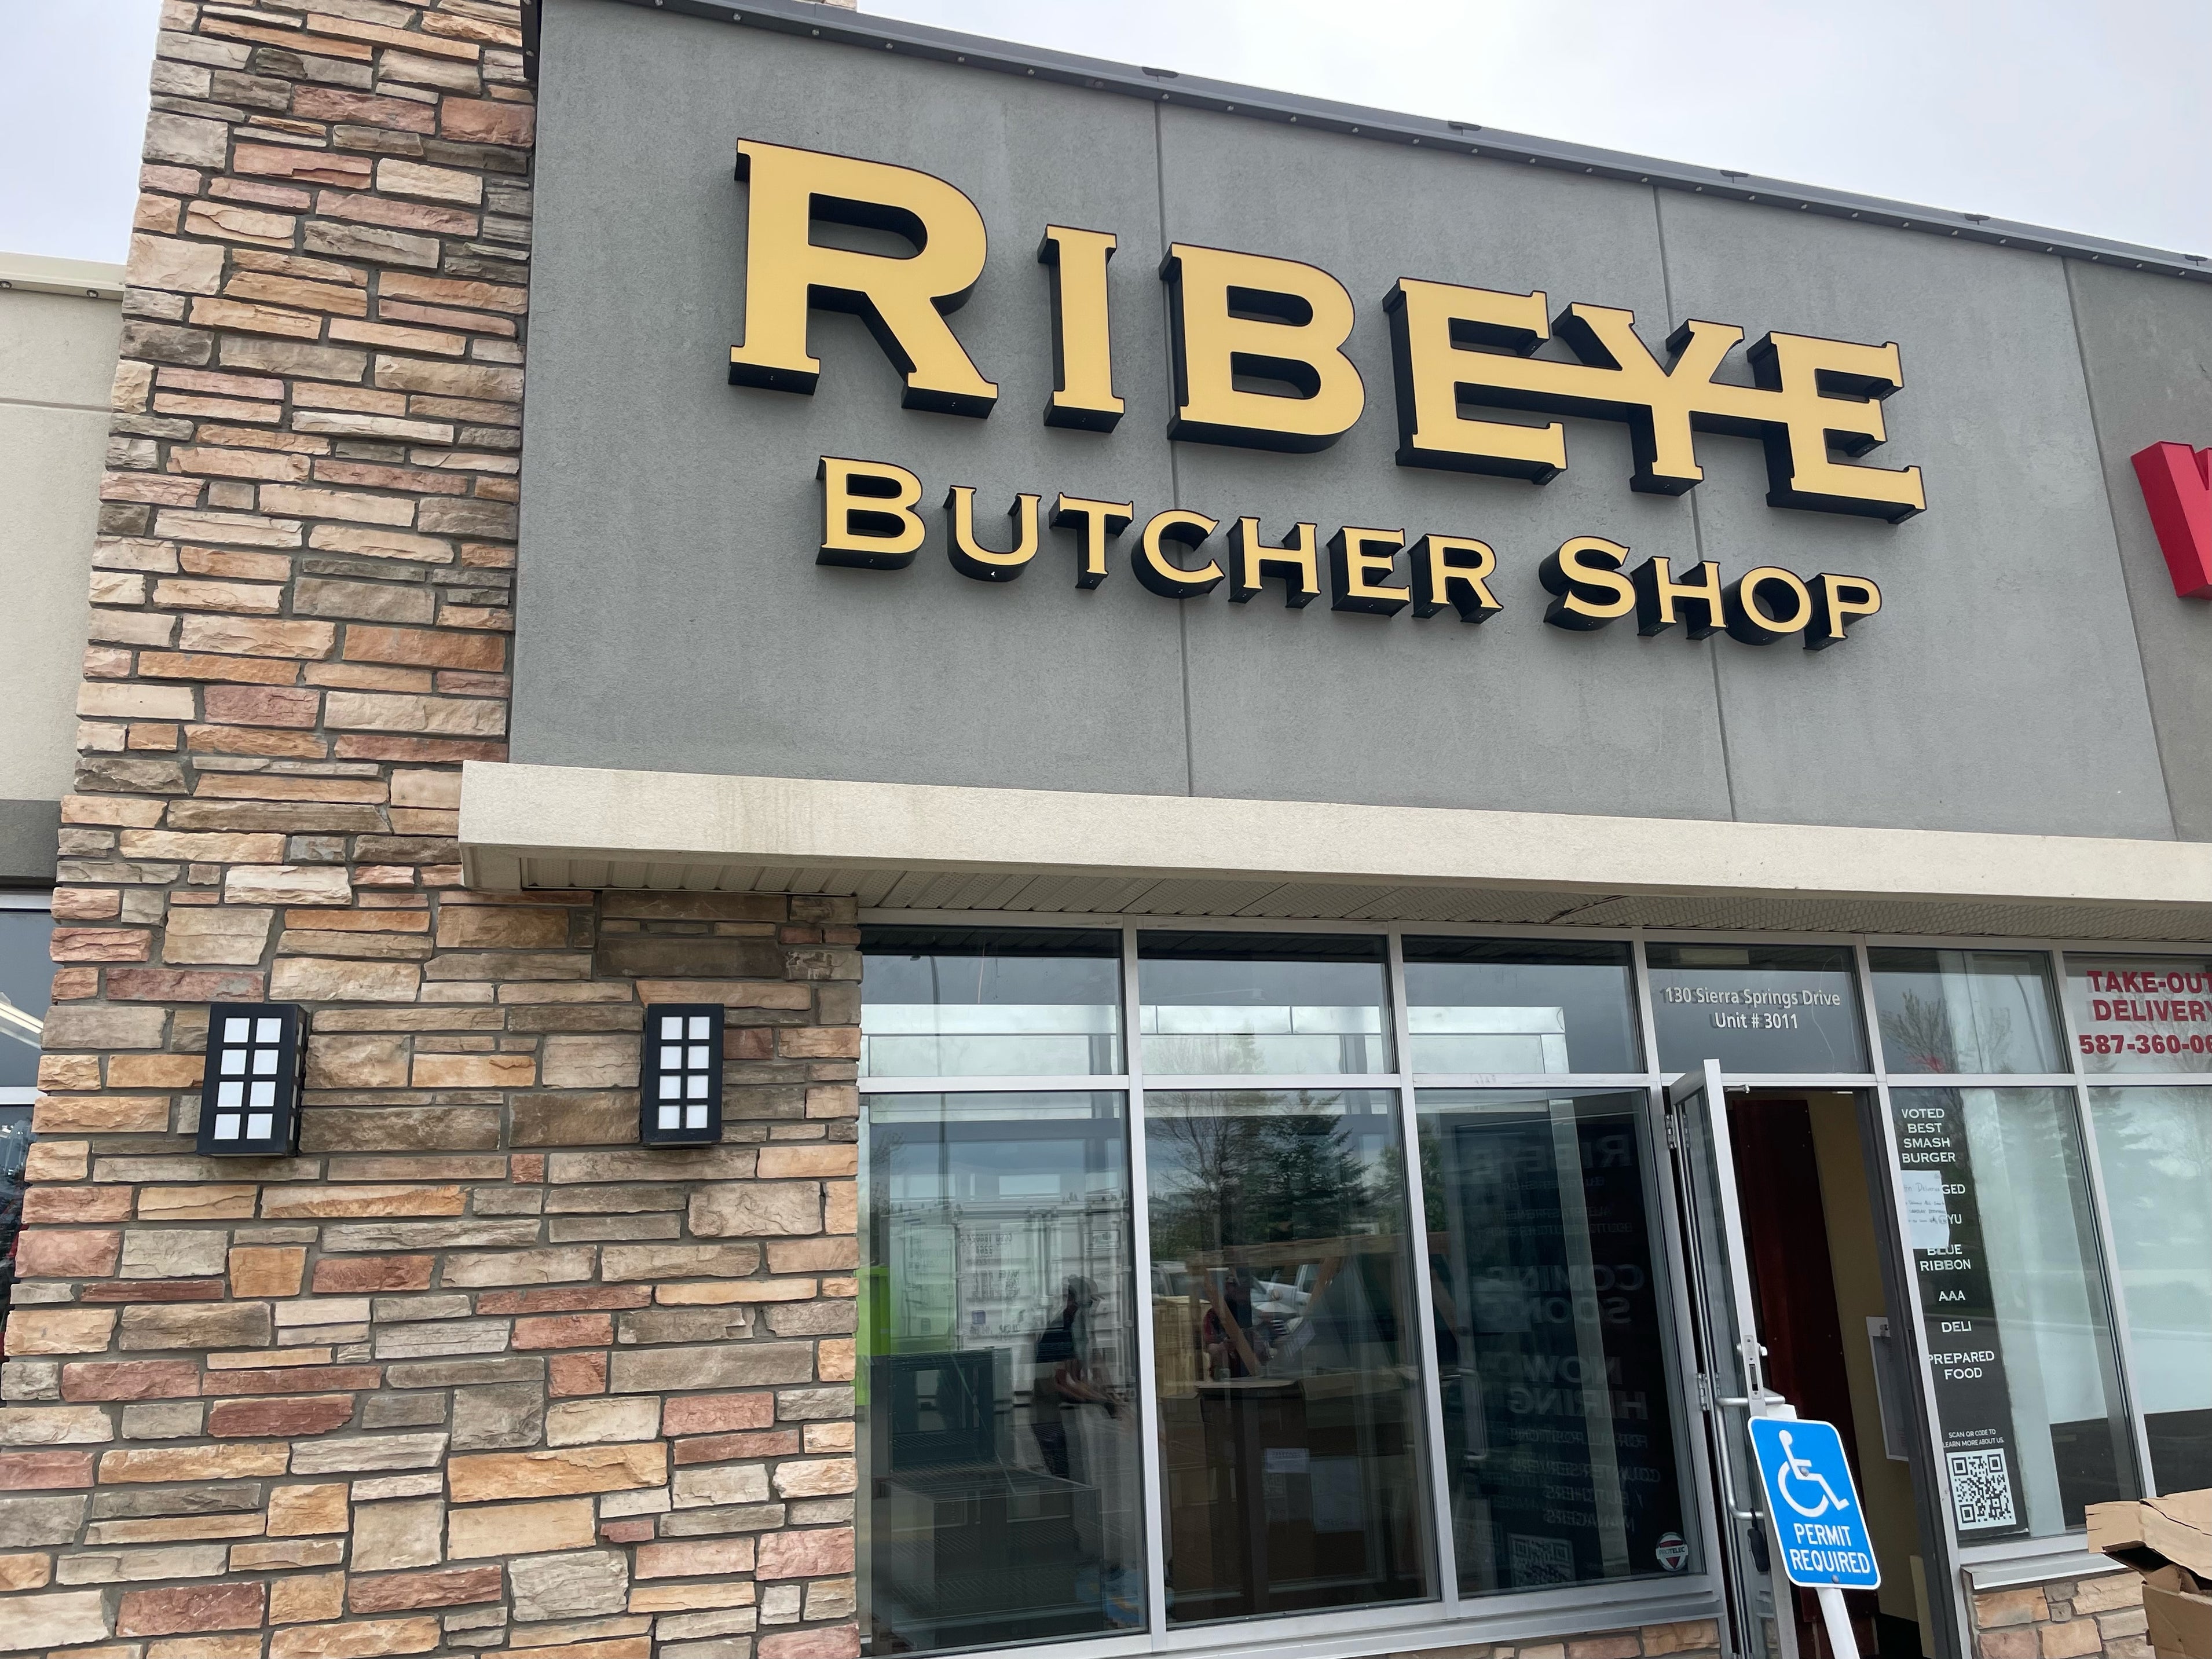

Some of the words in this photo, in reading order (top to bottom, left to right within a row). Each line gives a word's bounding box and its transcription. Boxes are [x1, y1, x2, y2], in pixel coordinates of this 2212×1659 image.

[728, 137, 1927, 523] RIBEYE
[815, 456, 1503, 622] BUTCHER
[1539, 536, 1882, 650] SHOP
[2087, 971, 2212, 994] TAKE-OUT
[1665, 987, 1692, 1003] 130
[1696, 987, 1739, 1004] Sierra
[1743, 988, 1799, 1009] Springs
[1802, 989, 1841, 1005] Drive
[1715, 1012, 1748, 1028] Unit
[1751, 1013, 1760, 1028] #
[1765, 1013, 1798, 1029] 3011
[1901, 1108, 1945, 1119] VOTED
[1907, 1122, 1943, 1133] BEST
[1903, 1137, 1950, 1148] SMASH
[1902, 1152, 1956, 1163] BURGER
[1942, 1184, 1966, 1195] GED
[1920, 1259, 1971, 1272] RIBBON
[1939, 1290, 1966, 1302] AAA
[1942, 1321, 1972, 1332] DELI
[1944, 1367, 1983, 1380] FOOD
[1979, 1437, 1995, 1445] ABOUT
[1793, 1523, 1852, 1547] PERMIT
[1789, 1548, 1870, 1574] REQUIRED
